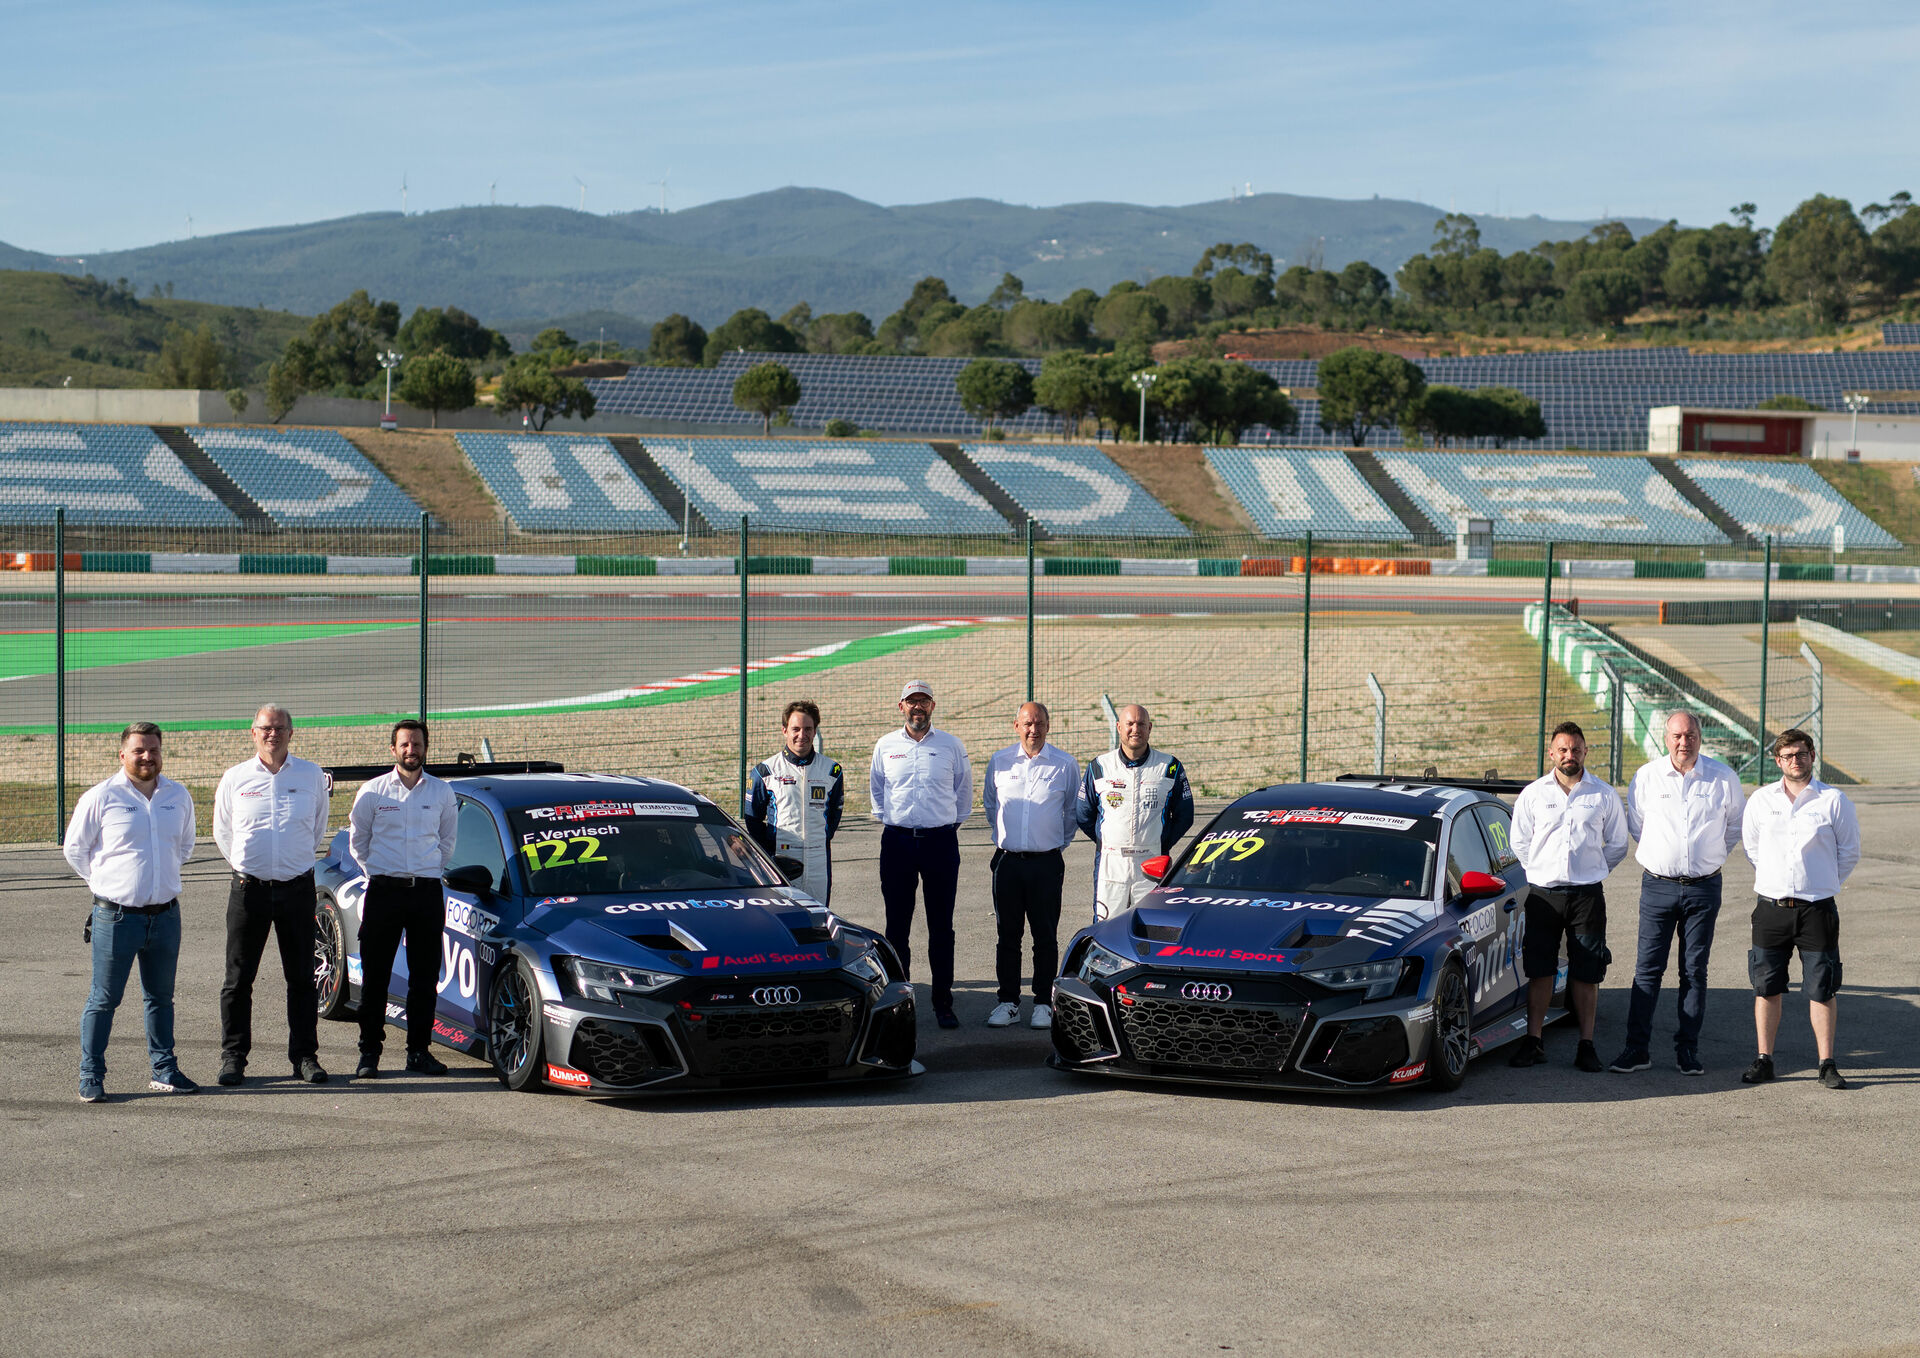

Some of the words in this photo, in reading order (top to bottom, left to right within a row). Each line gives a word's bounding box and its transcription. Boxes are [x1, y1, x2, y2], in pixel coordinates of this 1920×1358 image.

[525, 805, 574, 820] TCR
[1243, 810, 1288, 820] TCR
[1352, 815, 1386, 823] KUMHO
[520, 836, 608, 871] 122
[1189, 837, 1265, 865] 179
[604, 898, 795, 914] comtoyou
[1165, 896, 1363, 914] comtoyou
[724, 953, 767, 966] Audi
[769, 952, 824, 965] Sport
[1179, 946, 1226, 958] Audi
[1229, 949, 1286, 963] Sport
[549, 1067, 589, 1083] KUMHO
[1392, 1062, 1426, 1080] KUMHO
